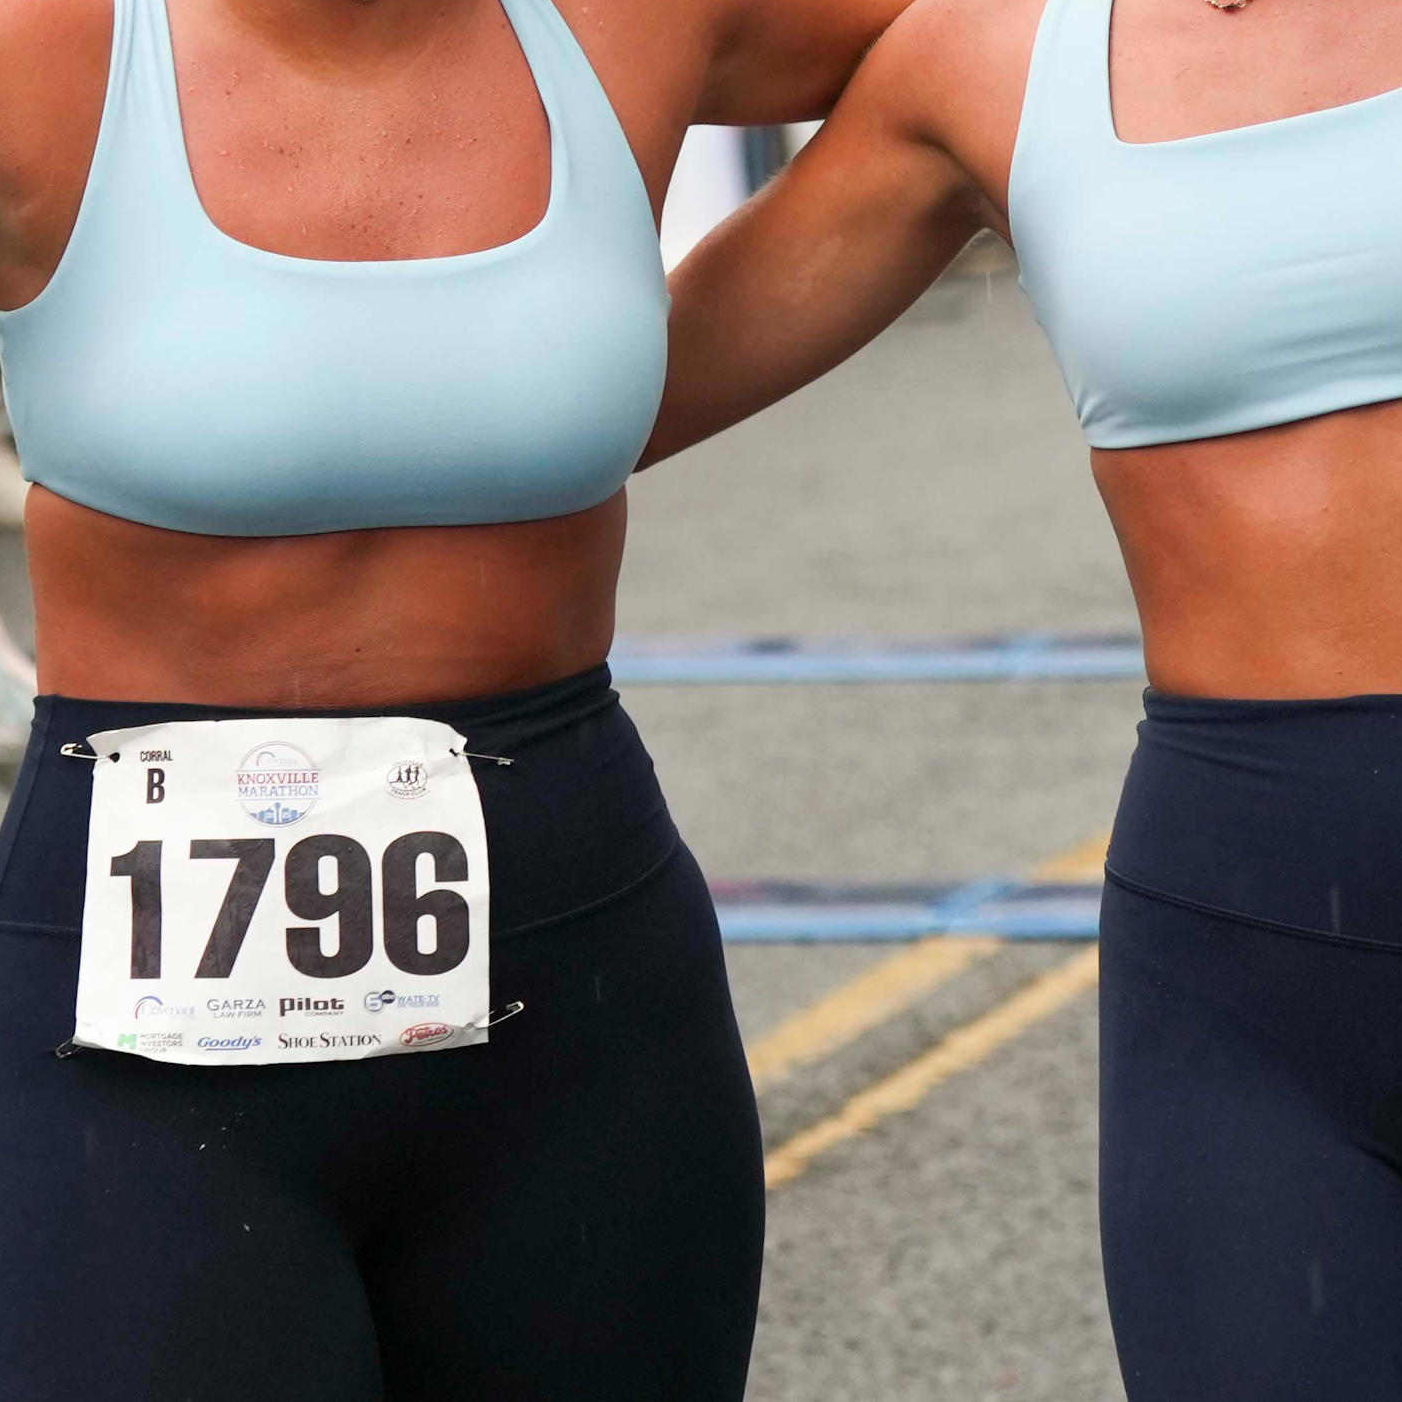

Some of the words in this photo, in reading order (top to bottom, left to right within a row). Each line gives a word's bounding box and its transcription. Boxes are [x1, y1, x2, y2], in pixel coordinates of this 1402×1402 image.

[139, 750, 173, 763] CORRAL
[237, 772, 319, 785] KNOXVILLE
[146, 768, 166, 805] B
[238, 785, 319, 798] MARATHON
[110, 830, 470, 980] 1796
[206, 999, 267, 1011] GARZA
[238, 1010, 262, 1018] FIRM
[198, 1035, 263, 1051] Goody's
